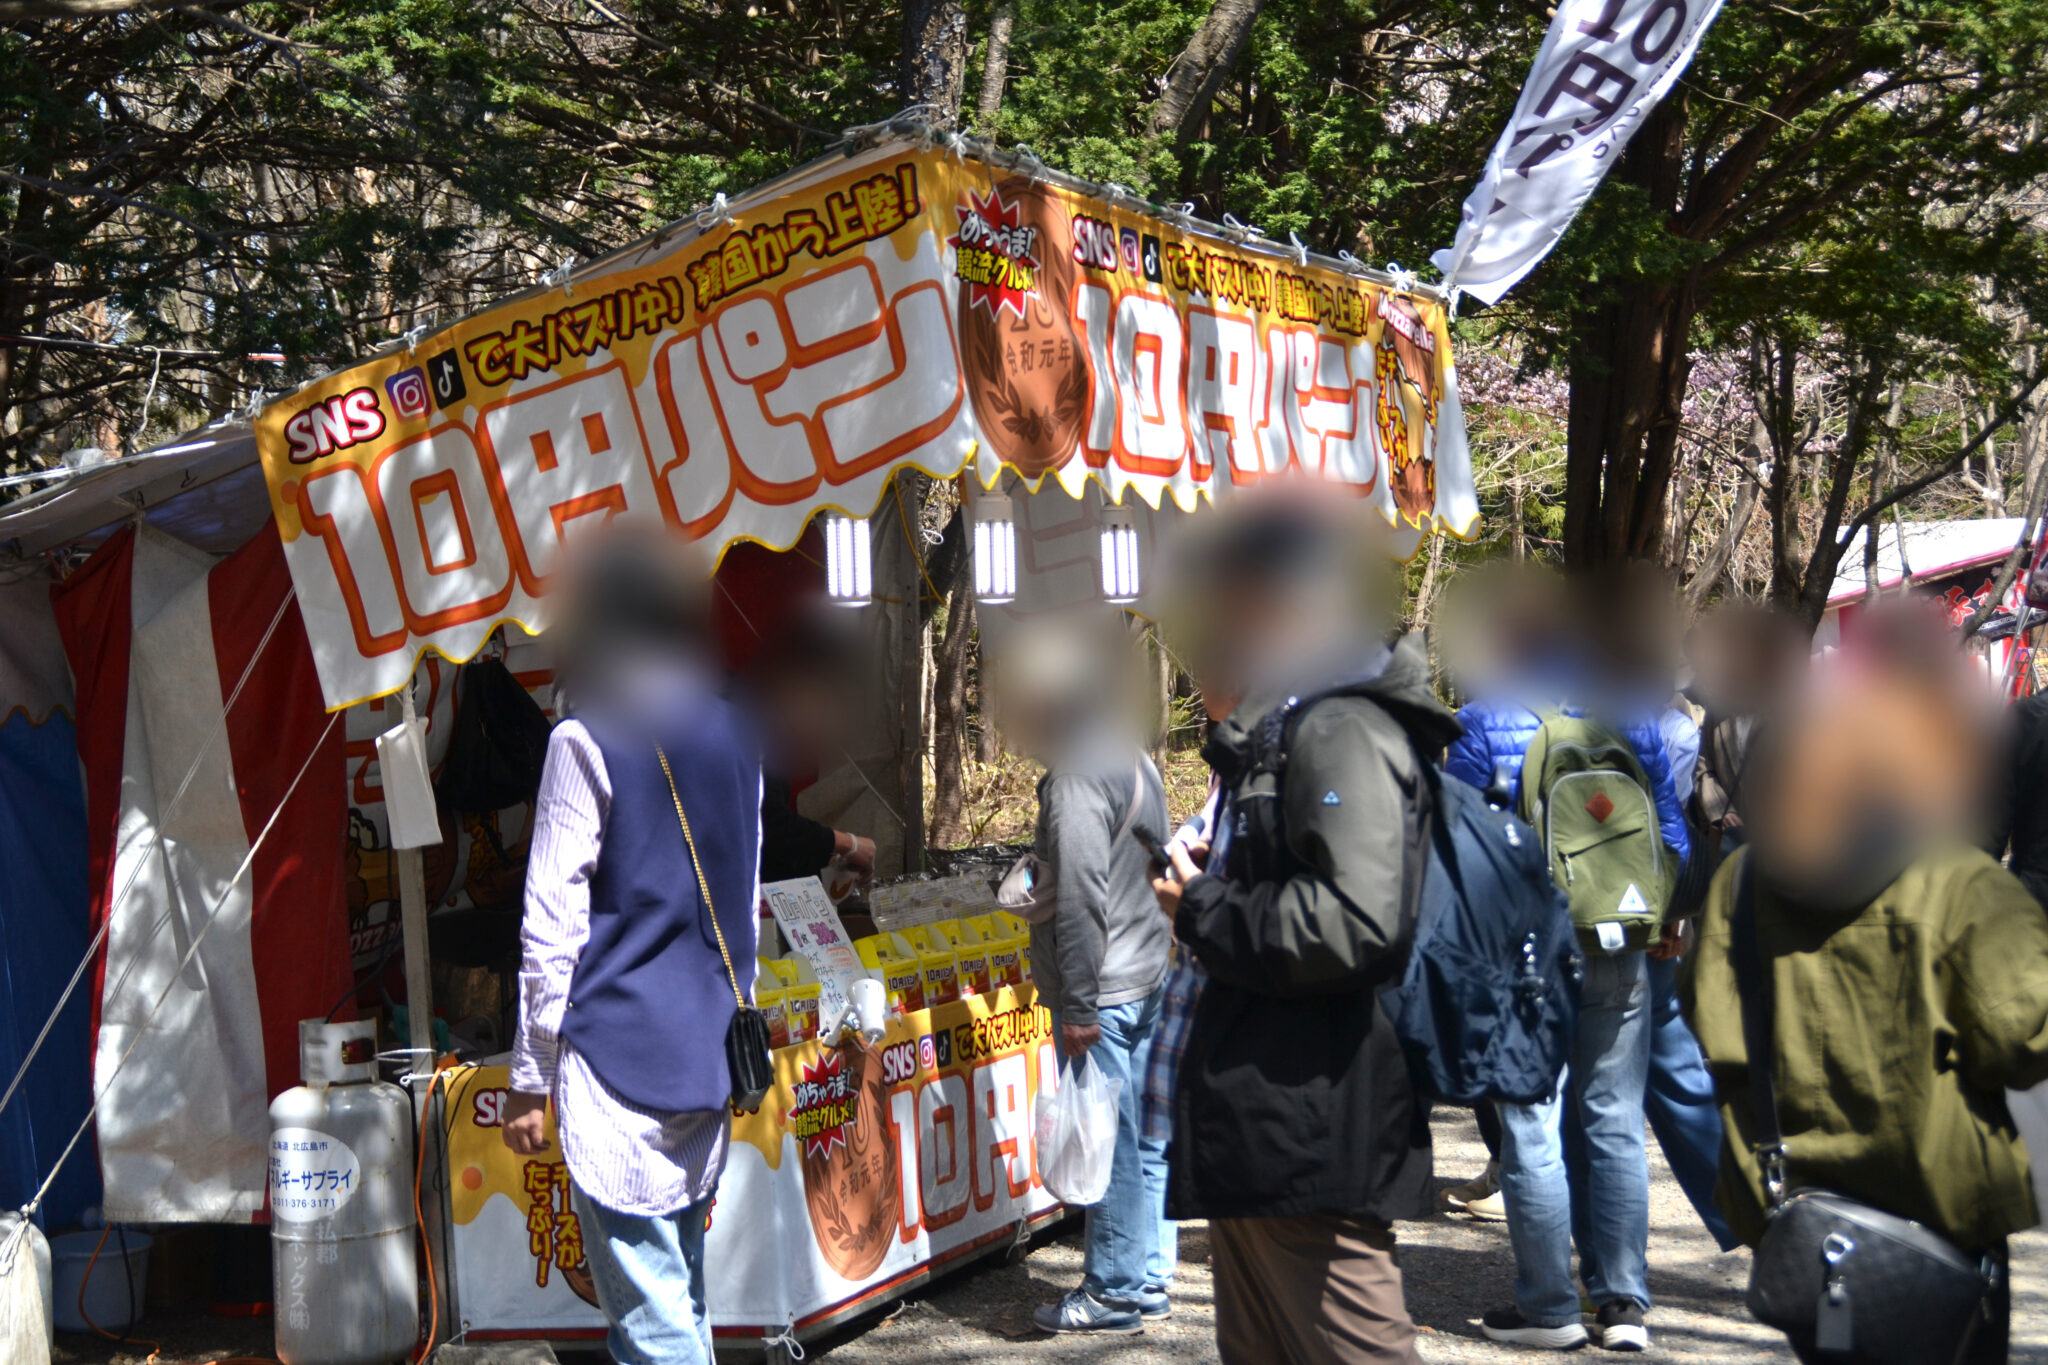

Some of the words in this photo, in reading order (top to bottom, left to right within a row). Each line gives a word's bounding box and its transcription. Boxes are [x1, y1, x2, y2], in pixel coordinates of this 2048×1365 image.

[1072, 213, 1118, 273] SNS
[284, 388, 386, 463] SNS
[685, 163, 920, 310] 韓国から上陸!
[1005, 336, 1072, 377] 令和元年
[1069, 276, 1378, 497] 10円パン
[298, 255, 962, 658] 10円パン
[795, 1069, 853, 1108] めちゃうま!
[881, 1041, 917, 1085] SNS
[293, 1141, 328, 1151] 北広島市
[795, 1098, 856, 1141] 韓流グルメ!
[838, 1153, 884, 1206] 令和元年
[524, 1160, 554, 1288] たっぷり!
